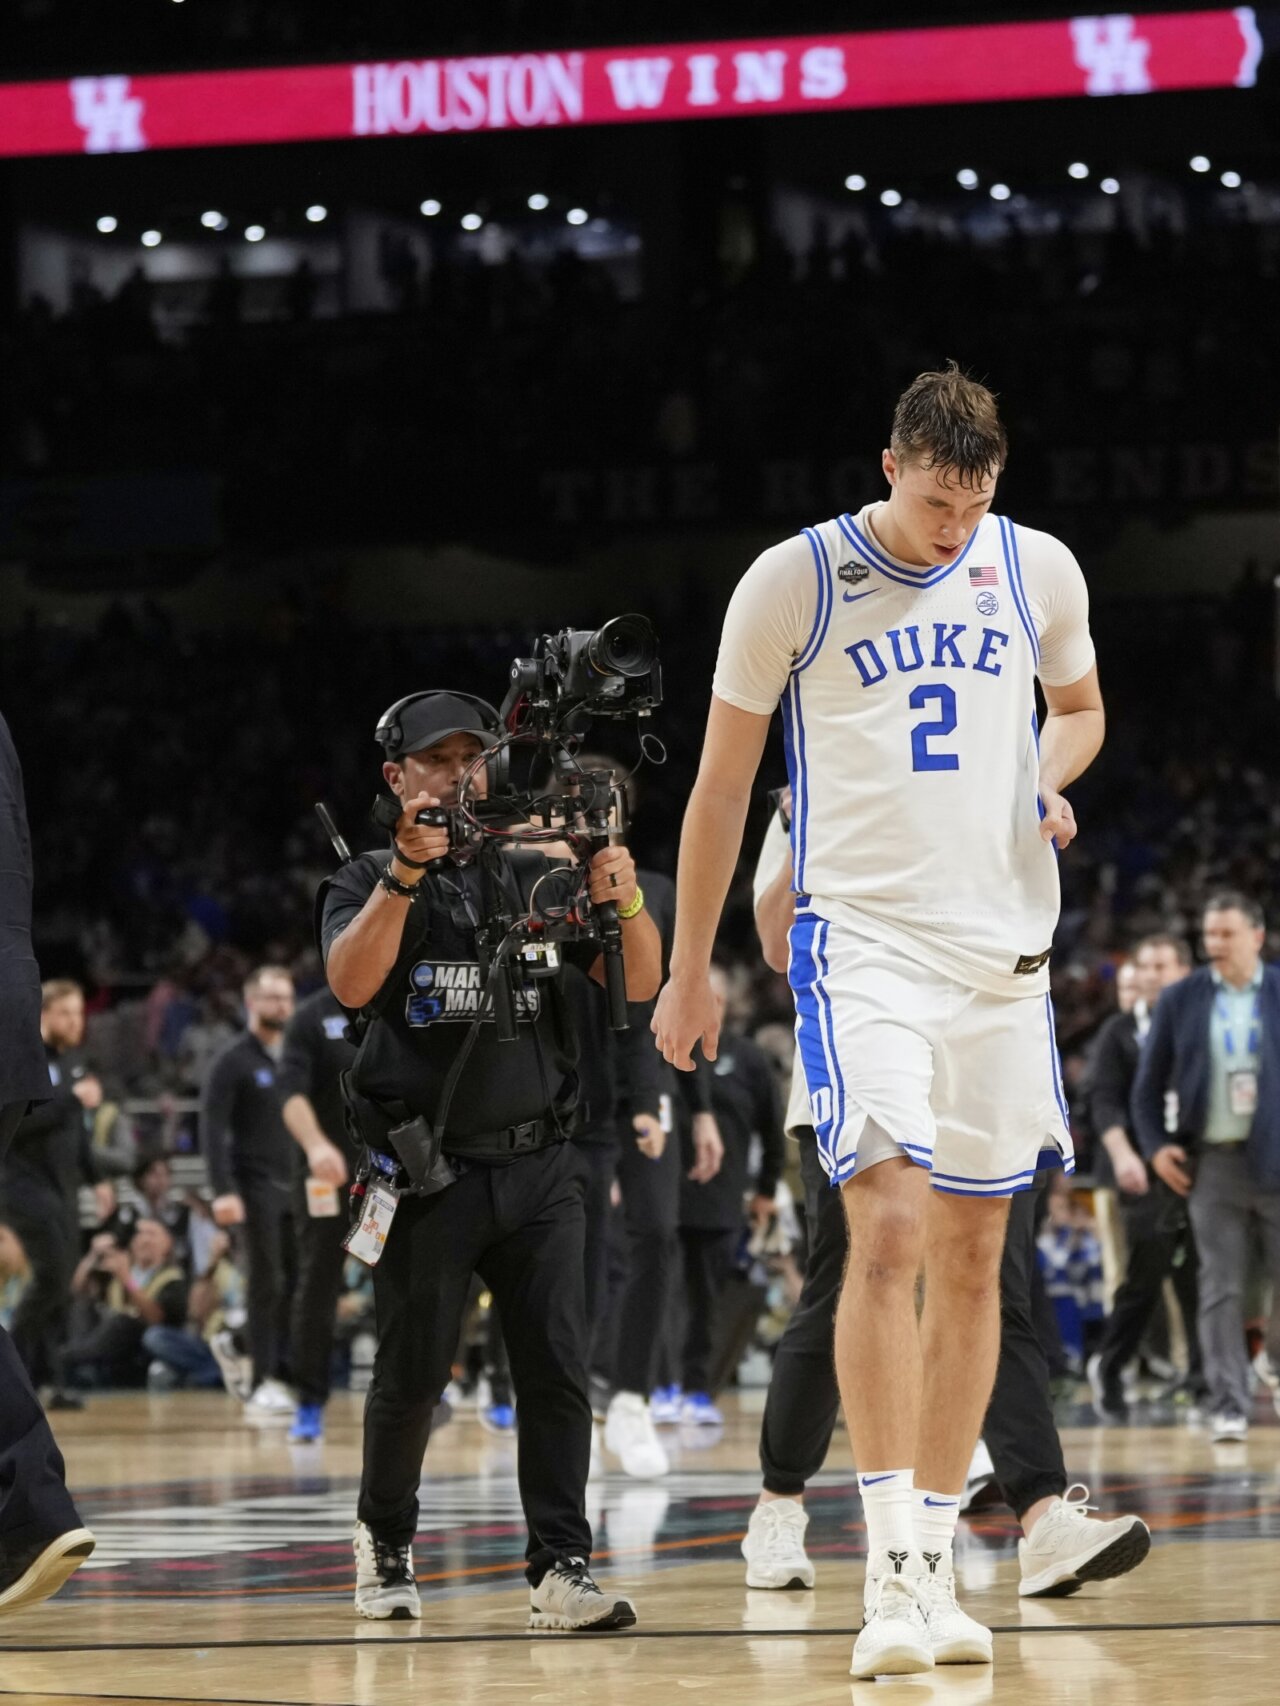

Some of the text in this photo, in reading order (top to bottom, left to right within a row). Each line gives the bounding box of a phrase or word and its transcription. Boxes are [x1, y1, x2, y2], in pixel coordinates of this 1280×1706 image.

[352, 47, 846, 135] HOUSTON WINS
[844, 623, 1009, 688] DUKE
[909, 683, 960, 772] 2
